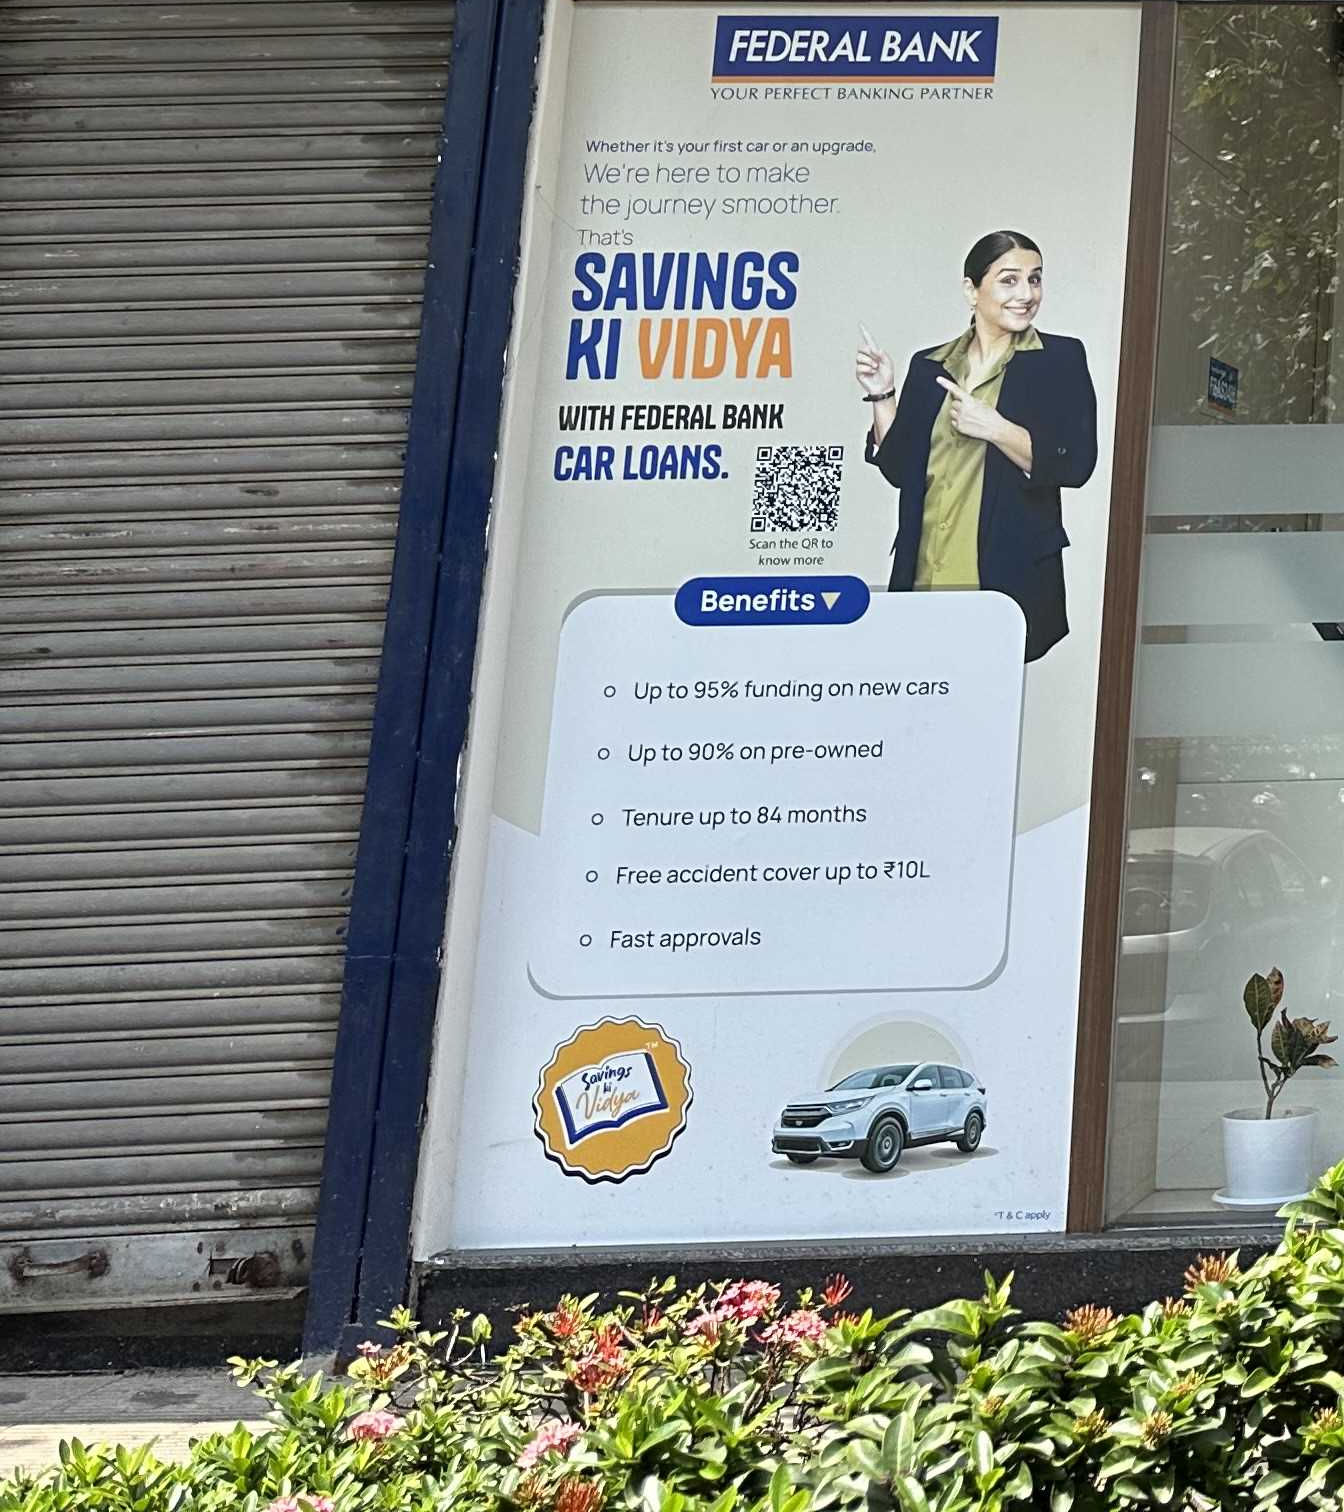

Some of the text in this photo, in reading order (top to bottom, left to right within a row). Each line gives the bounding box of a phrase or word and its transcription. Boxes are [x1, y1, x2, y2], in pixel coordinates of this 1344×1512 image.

[728, 30, 983, 63] FEDERAL BANK
[711, 87, 994, 101] YOUR PERFECT BANKING PARTNER
[586, 140, 649, 154] Whether
[653, 140, 674, 154] it's
[677, 142, 710, 156] your
[713, 140, 743, 153] first
[746, 141, 769, 153] car
[773, 141, 788, 153] or
[790, 141, 809, 152] an
[584, 163, 810, 185] We're here to make
[572, 251, 799, 311] SAVINGS
[565, 317, 792, 380] KI VIDYA
[559, 403, 784, 431] WITH FEDERAL BANK
[554, 444, 728, 482] CAR LOANS.
[750, 538, 833, 551] Scan the QR to
[758, 555, 824, 565] know more
[700, 589, 815, 614] Benefits
[634, 679, 949, 704] Up to 95% funding on new cars
[623, 805, 866, 830] Tenure up to 84 months
[610, 927, 761, 952] Fast approvals
